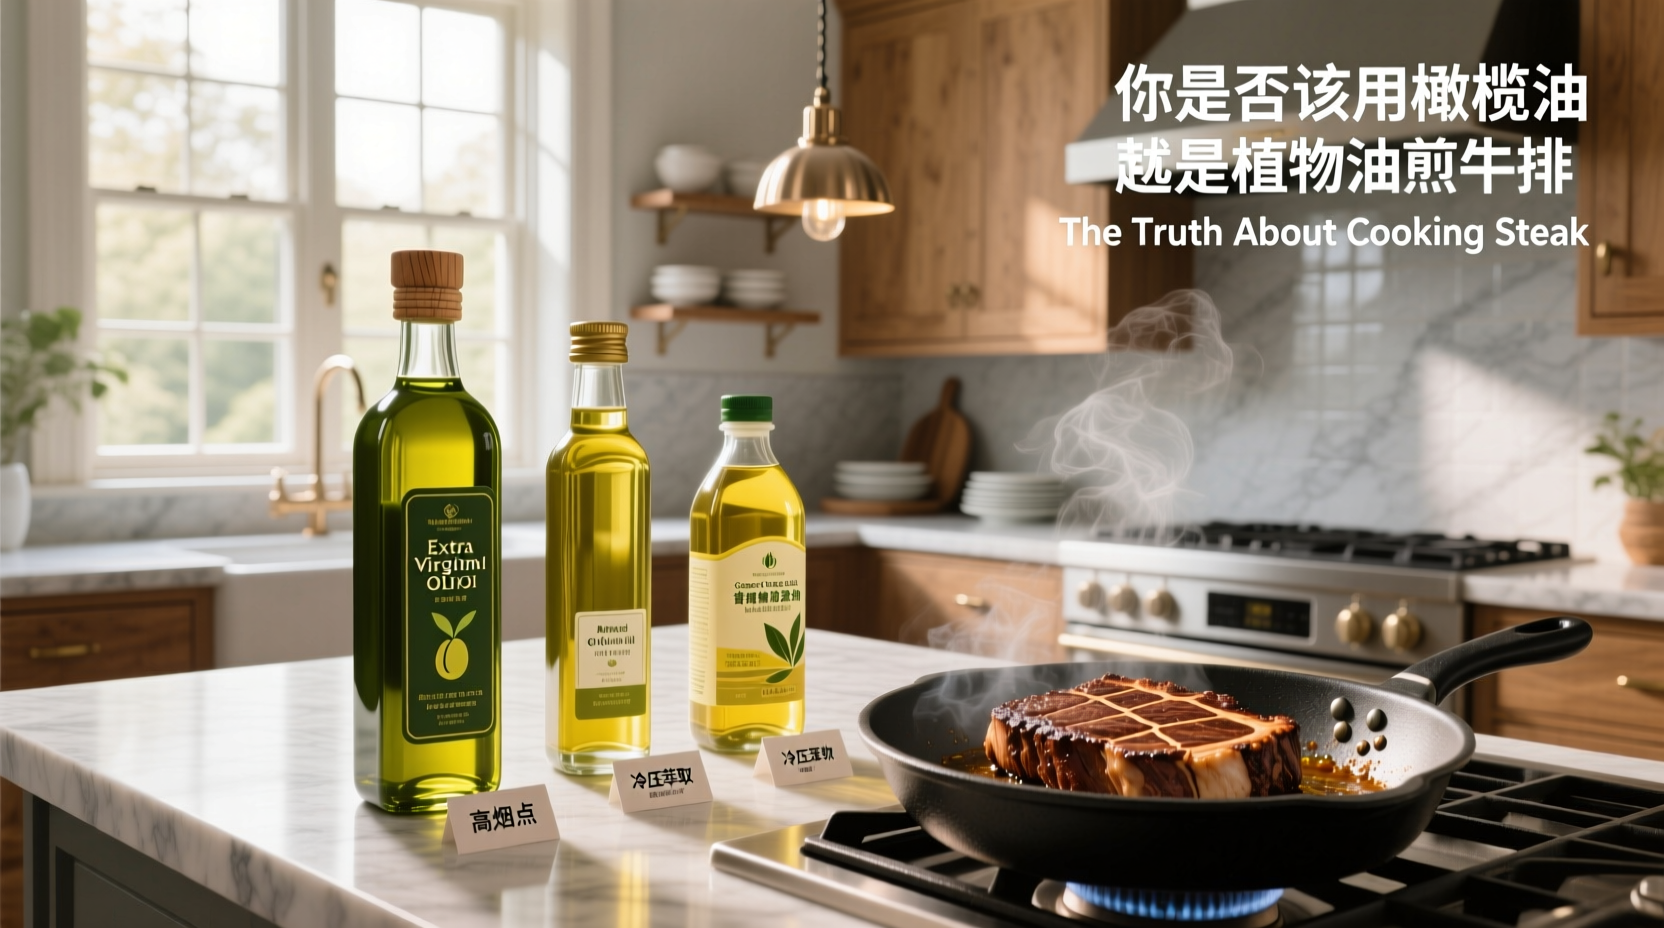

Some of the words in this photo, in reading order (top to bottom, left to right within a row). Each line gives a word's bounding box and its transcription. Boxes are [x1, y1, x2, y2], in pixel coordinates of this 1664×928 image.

[428, 539, 474, 555] Extra
[469, 802, 538, 834] 高烟点
